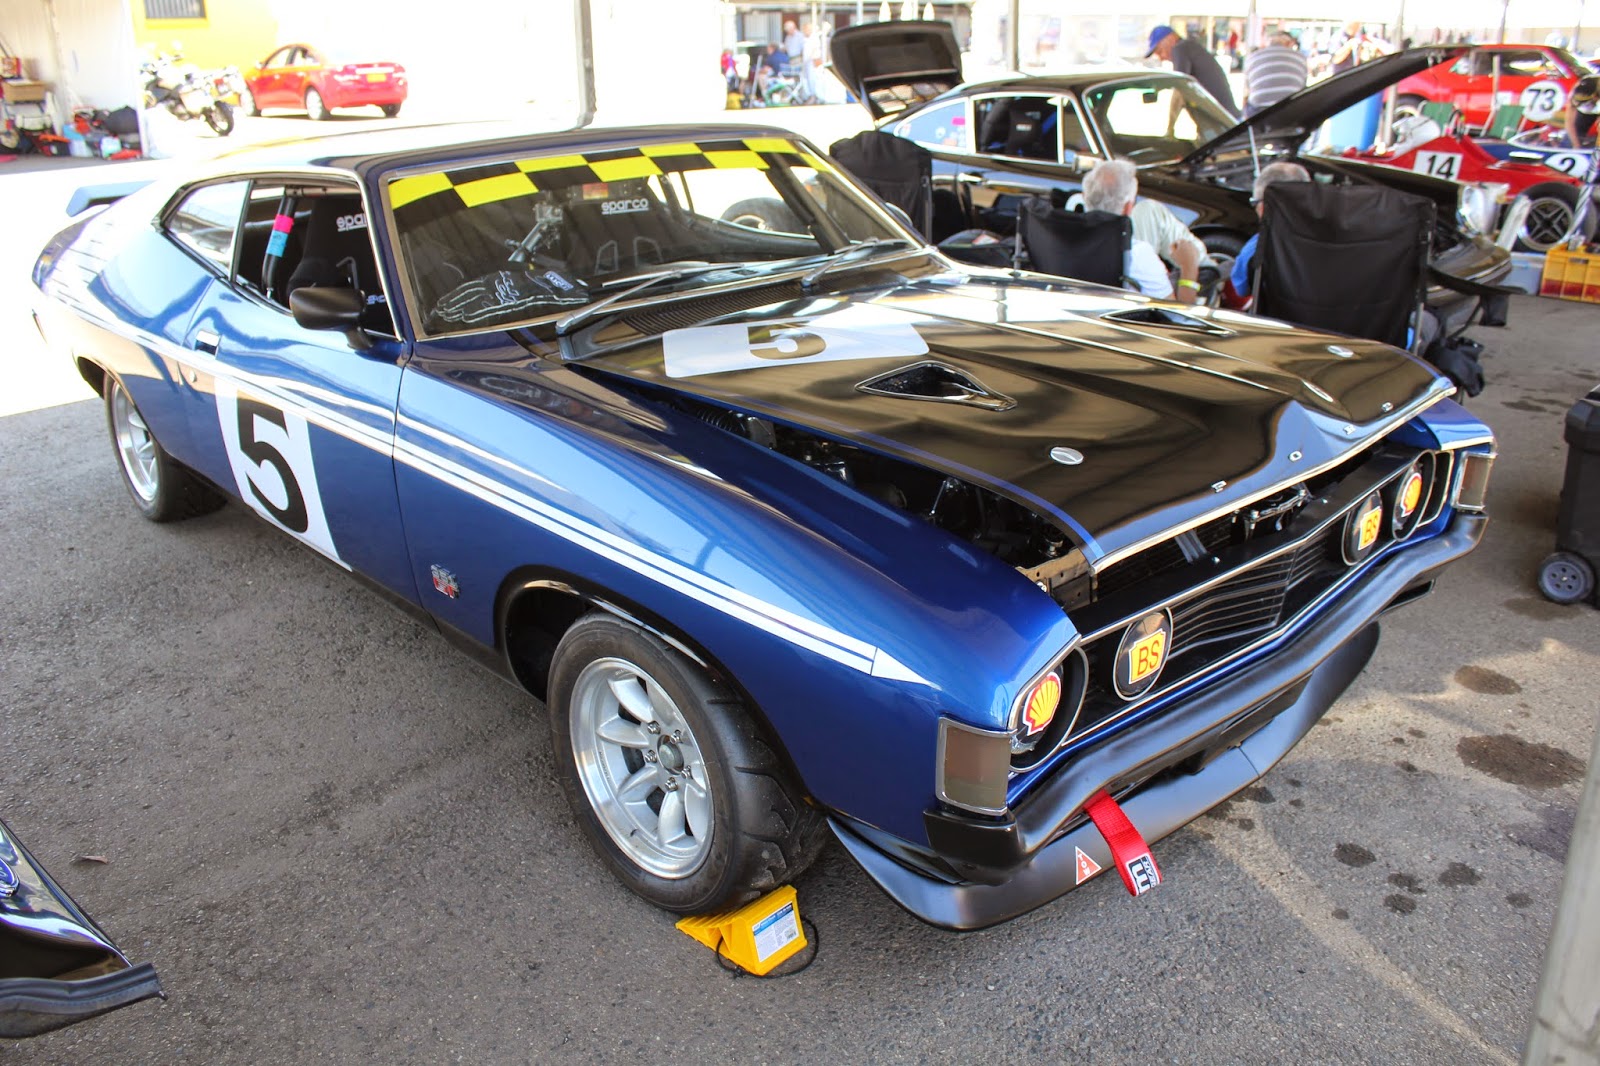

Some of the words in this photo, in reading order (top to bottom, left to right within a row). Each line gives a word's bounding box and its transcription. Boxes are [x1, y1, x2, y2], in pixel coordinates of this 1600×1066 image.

[1527, 88, 1557, 112] 73
[1427, 154, 1455, 179] 14
[1560, 157, 1577, 175] 2
[601, 198, 649, 215] sparco
[747, 321, 827, 360] 5
[237, 390, 309, 534] 5
[1137, 639, 1160, 677] BS
[1077, 853, 1091, 876] TOW
